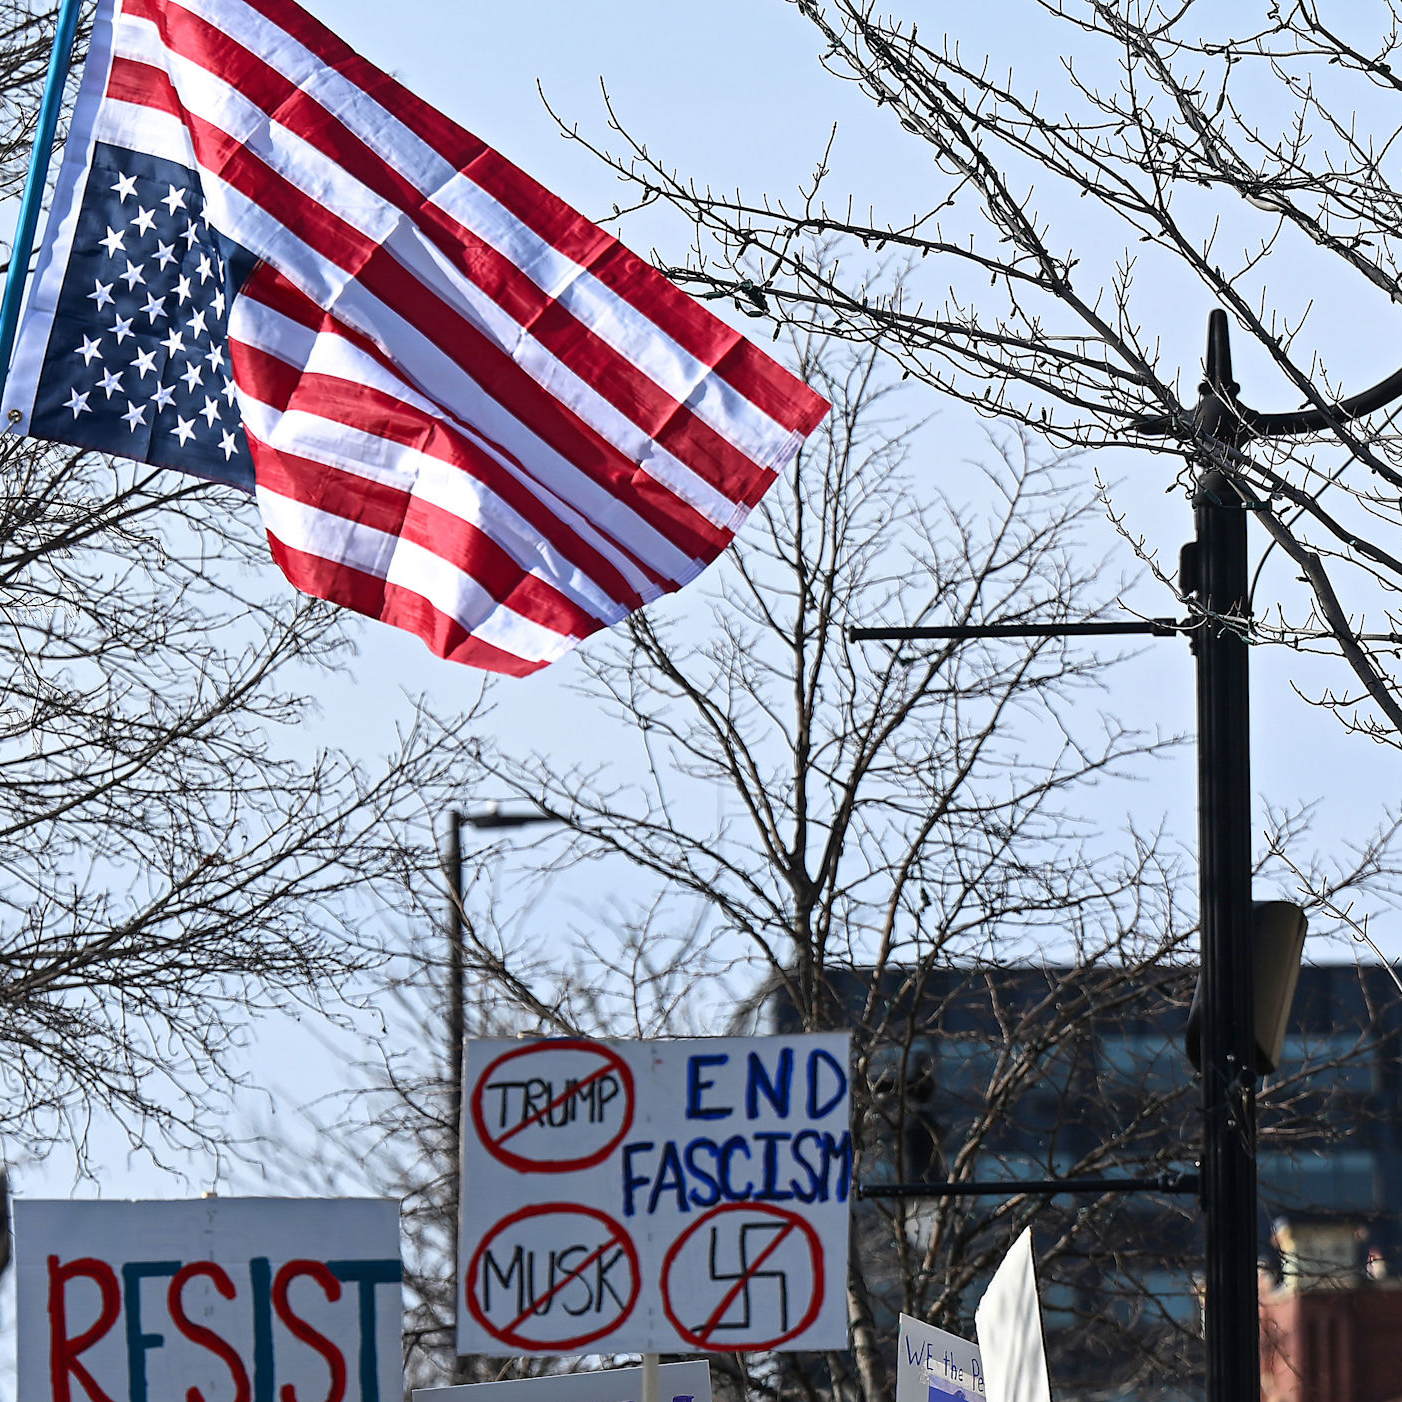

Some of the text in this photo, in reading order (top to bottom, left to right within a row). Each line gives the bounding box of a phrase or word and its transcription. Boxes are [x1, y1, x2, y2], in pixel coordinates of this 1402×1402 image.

[485, 1074, 620, 1128] TRUMP
[686, 1047, 847, 1120] END
[622, 1128, 852, 1217] FASCISM
[483, 1244, 626, 1317] MUSK
[943, 1350, 964, 1382] the
[971, 1357, 986, 1393] Pe
